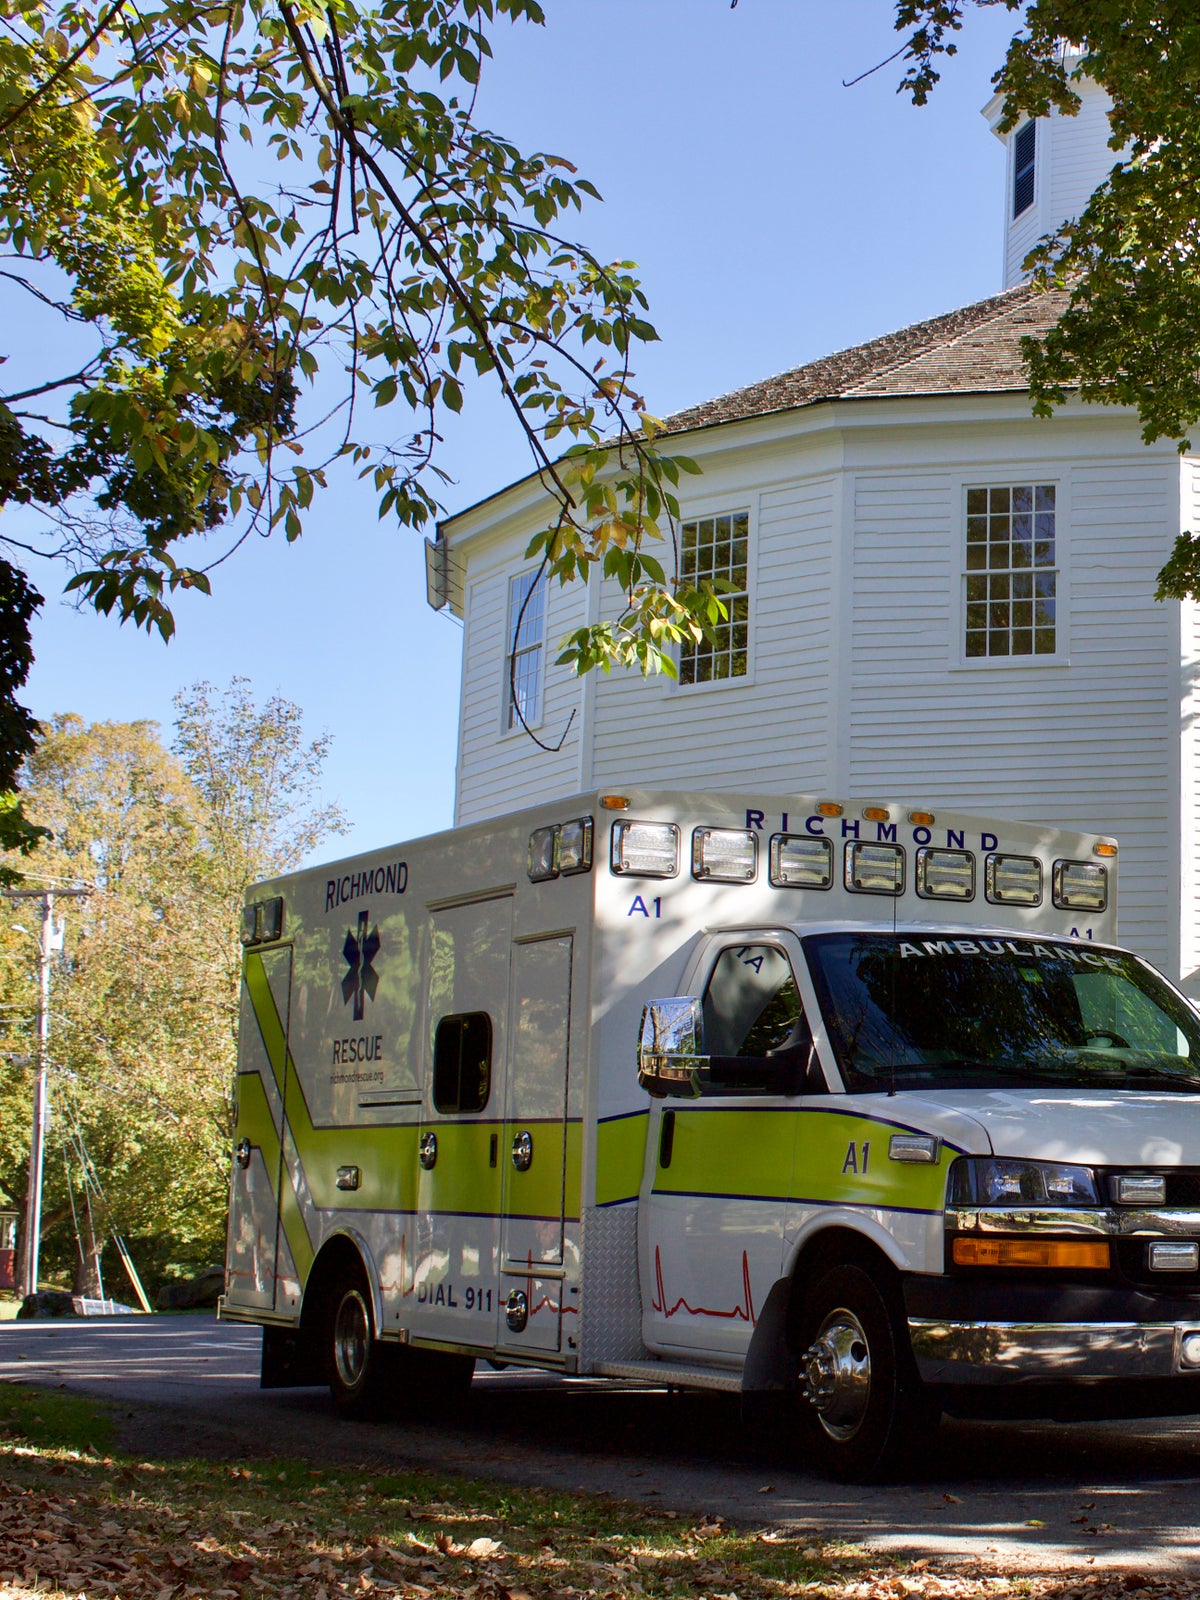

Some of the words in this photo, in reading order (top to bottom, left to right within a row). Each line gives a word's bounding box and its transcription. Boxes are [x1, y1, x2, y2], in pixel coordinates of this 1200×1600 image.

[746, 809, 999, 851] RICHMOND
[325, 862, 408, 913] RICHMOND
[628, 895, 662, 918] A1
[899, 940, 1125, 972] AMBULANCE
[332, 1035, 383, 1064] RESCUE
[330, 1071, 384, 1085] richmondrescue.org
[841, 1141, 870, 1174] A1
[418, 1281, 458, 1307] DIAL
[465, 1286, 492, 1312] 911
